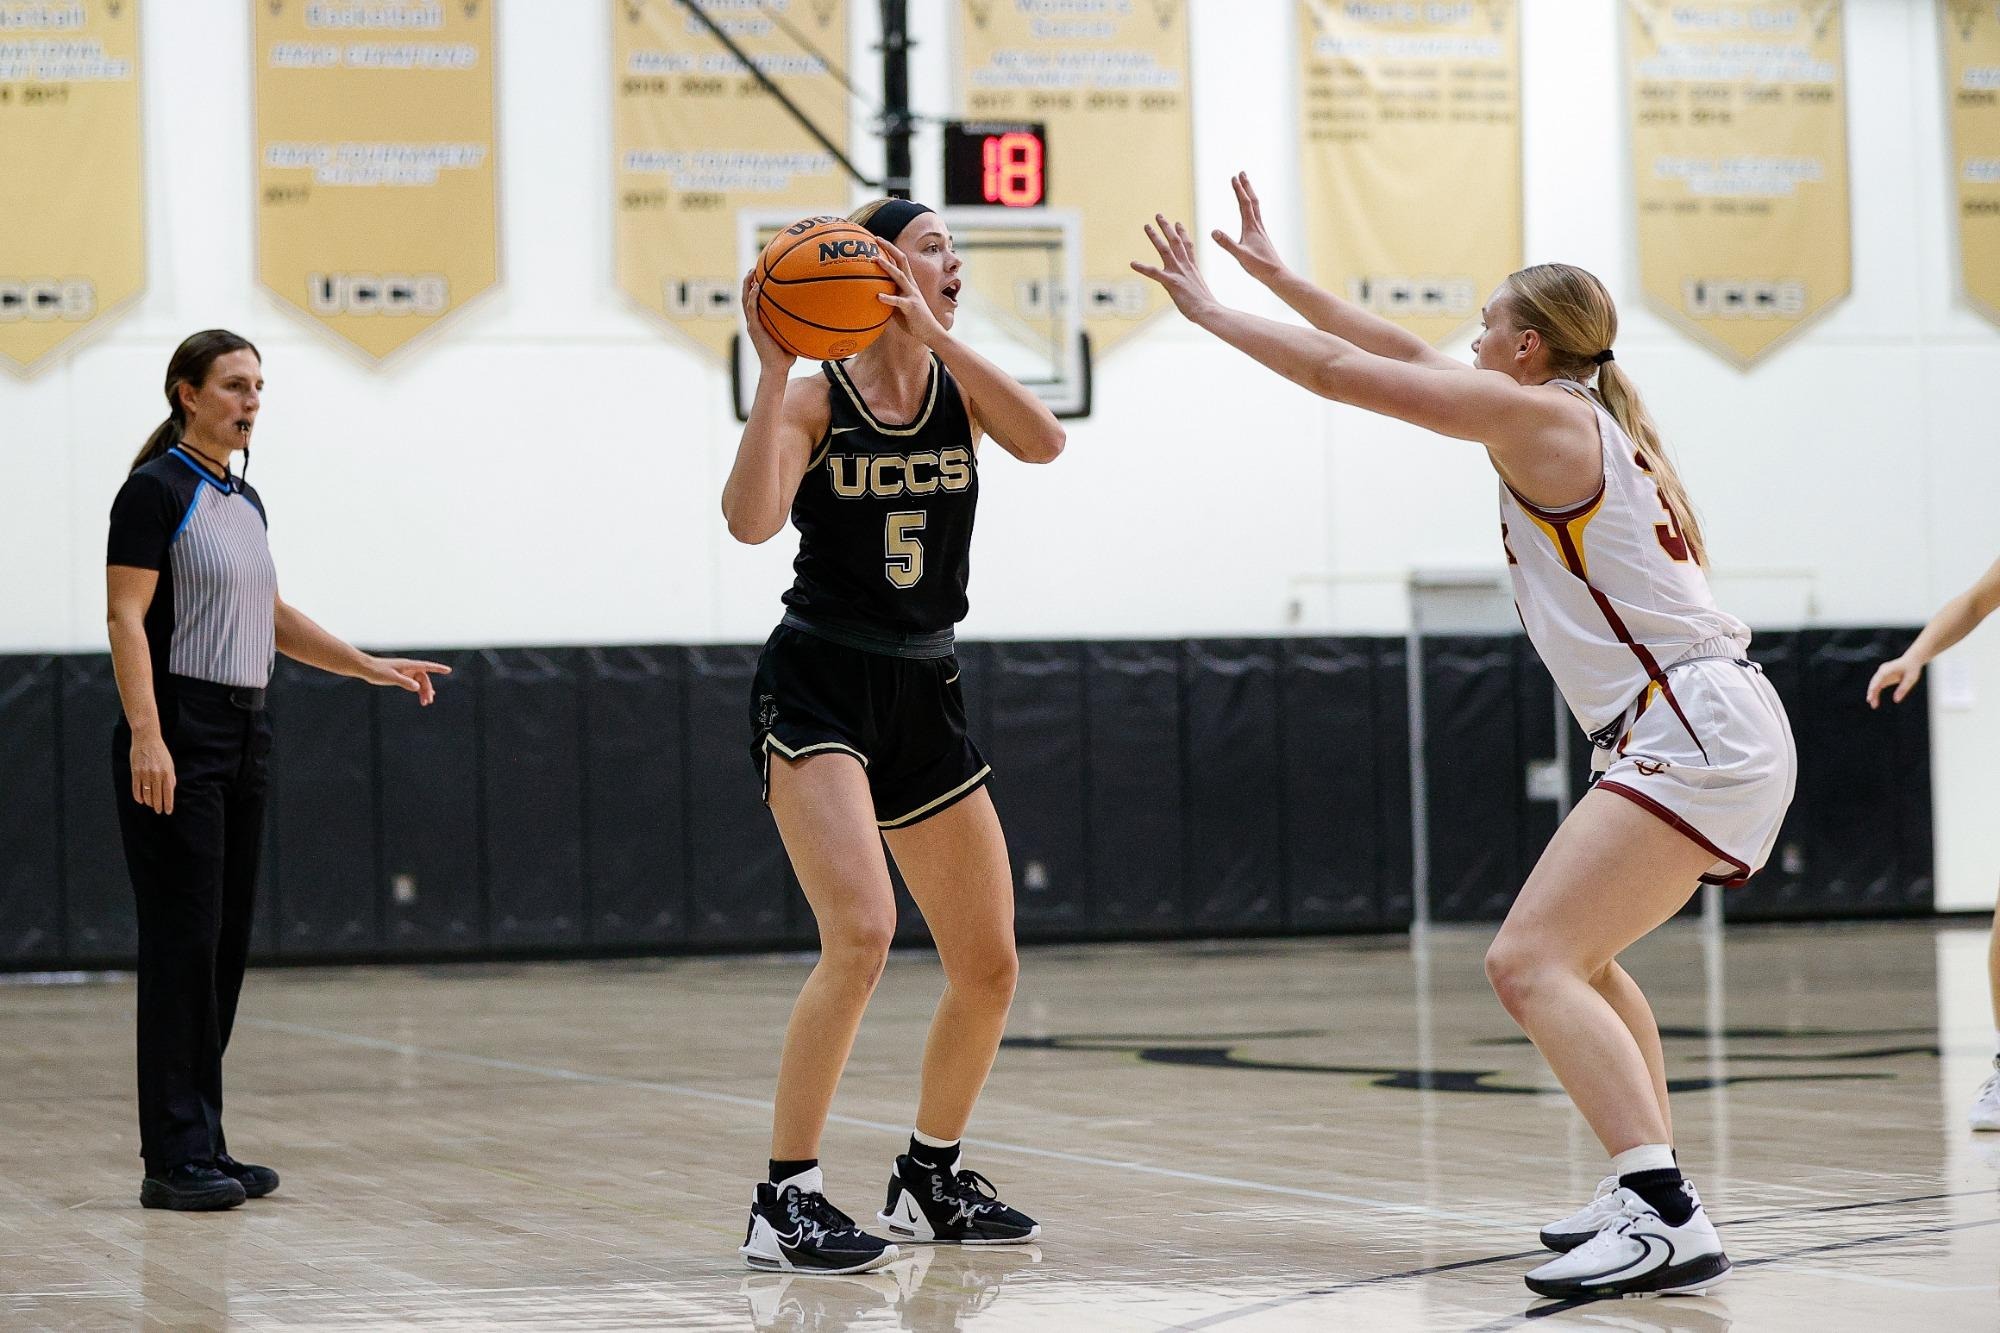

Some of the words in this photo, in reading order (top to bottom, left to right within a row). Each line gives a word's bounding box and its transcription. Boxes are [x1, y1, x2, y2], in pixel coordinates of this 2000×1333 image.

[982, 134, 1044, 206] 18
[818, 240, 880, 263] NCAA
[306, 273, 449, 316] UCCS
[664, 278, 740, 316] UC
[1346, 275, 1473, 314] UCCS
[1682, 276, 1806, 316] UCCS
[827, 445, 973, 500] UCCS
[884, 509, 927, 589] 5
